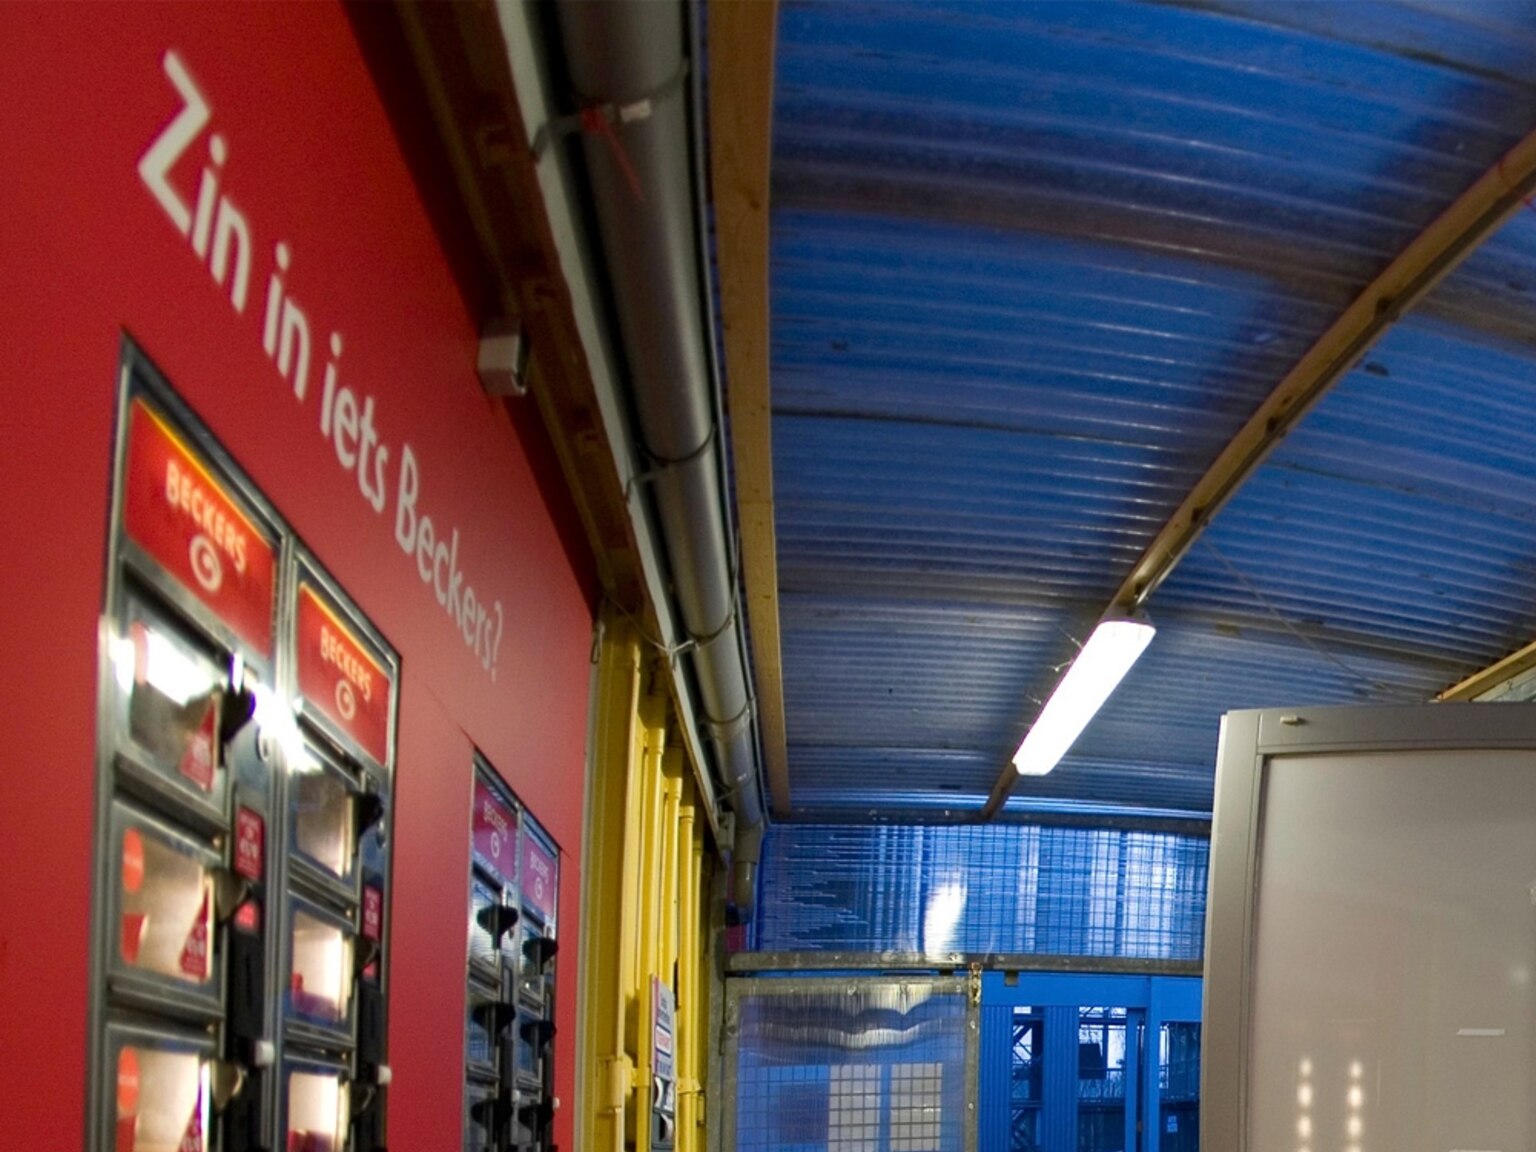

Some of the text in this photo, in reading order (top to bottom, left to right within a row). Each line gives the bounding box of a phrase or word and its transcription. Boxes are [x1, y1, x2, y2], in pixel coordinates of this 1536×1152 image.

[137, 48, 503, 684] Zin in iets Beckers?
[164, 458, 248, 574] BECKERS
[319, 626, 372, 702] BECKERS
